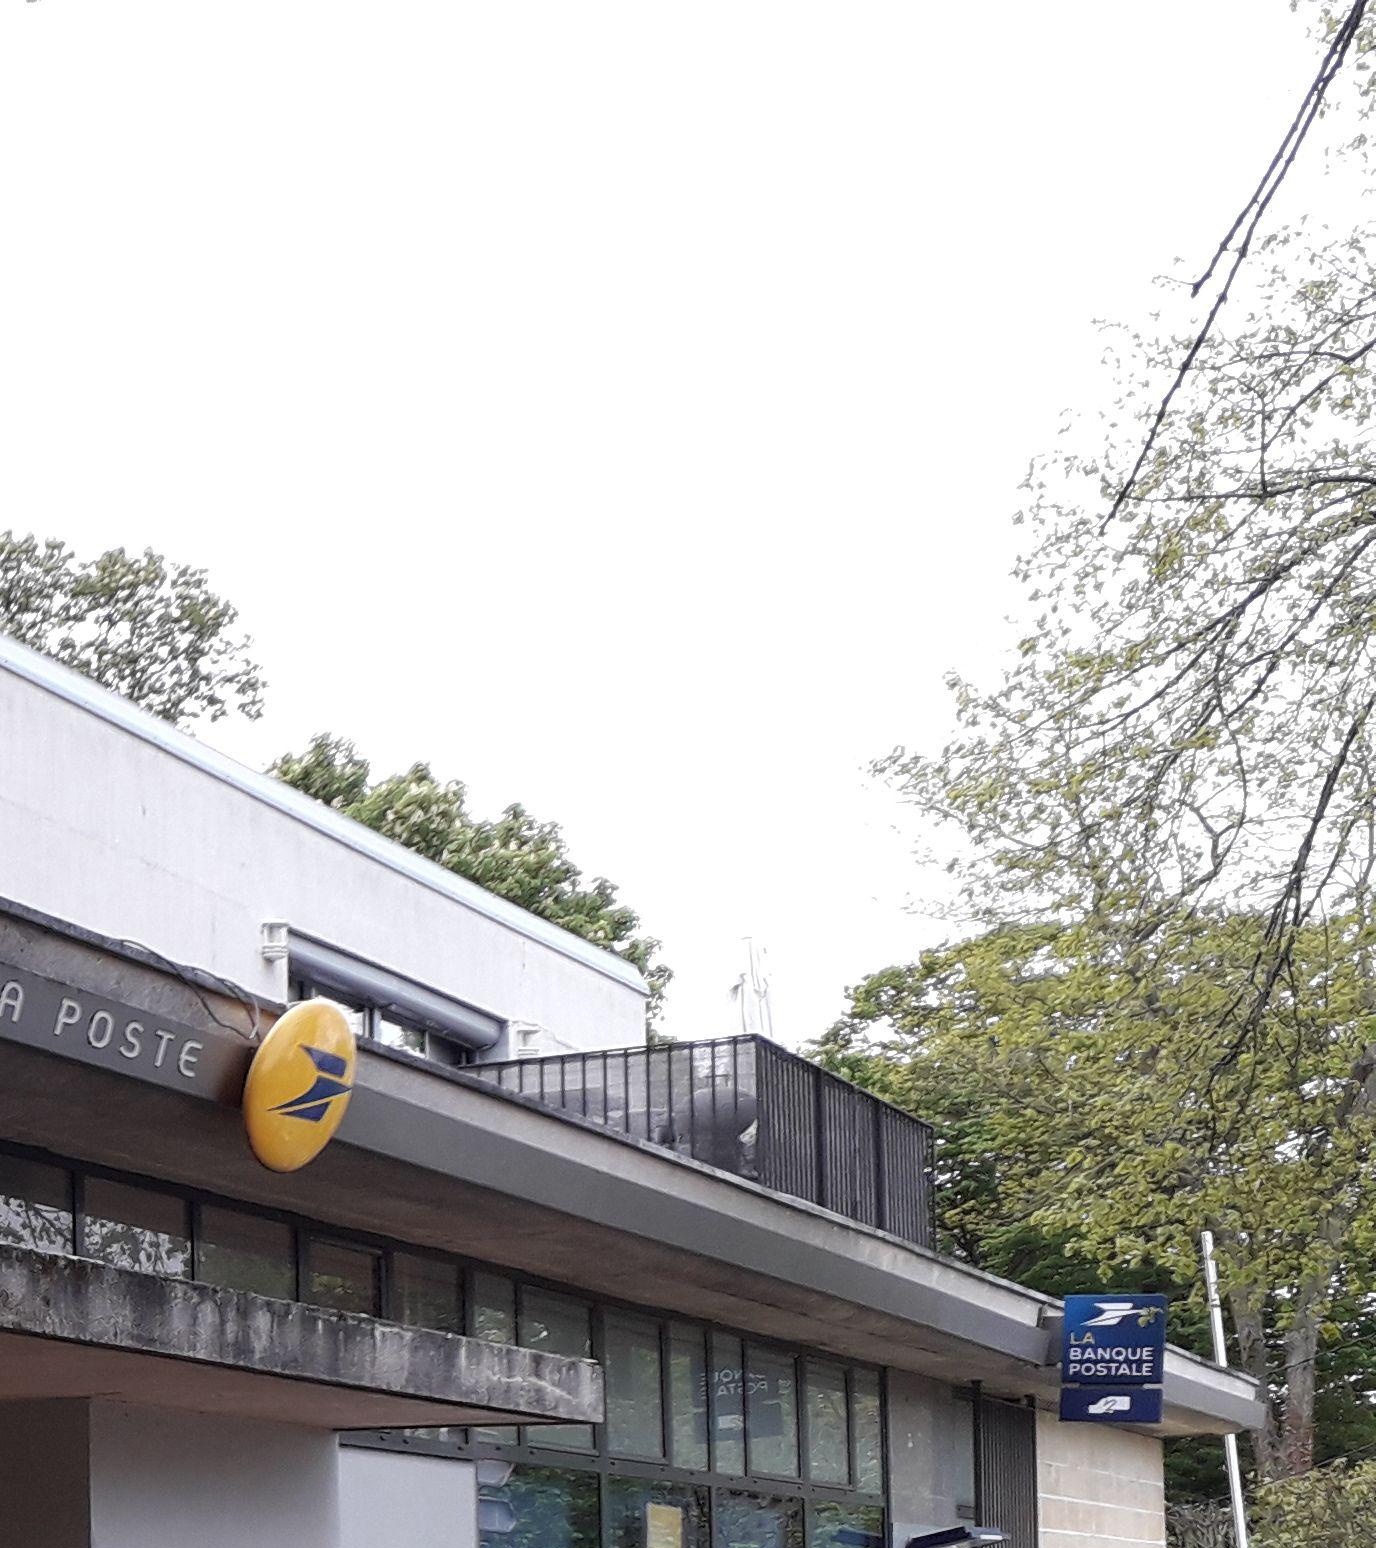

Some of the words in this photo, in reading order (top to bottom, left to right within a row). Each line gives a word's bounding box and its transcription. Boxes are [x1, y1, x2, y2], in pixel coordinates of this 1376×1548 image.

[53, 997, 204, 1079] POSTE
[1070, 1331, 1096, 1345] LA
[1069, 1347, 1154, 1362] BANQUE
[1069, 1362, 1154, 1376] POSTALE
